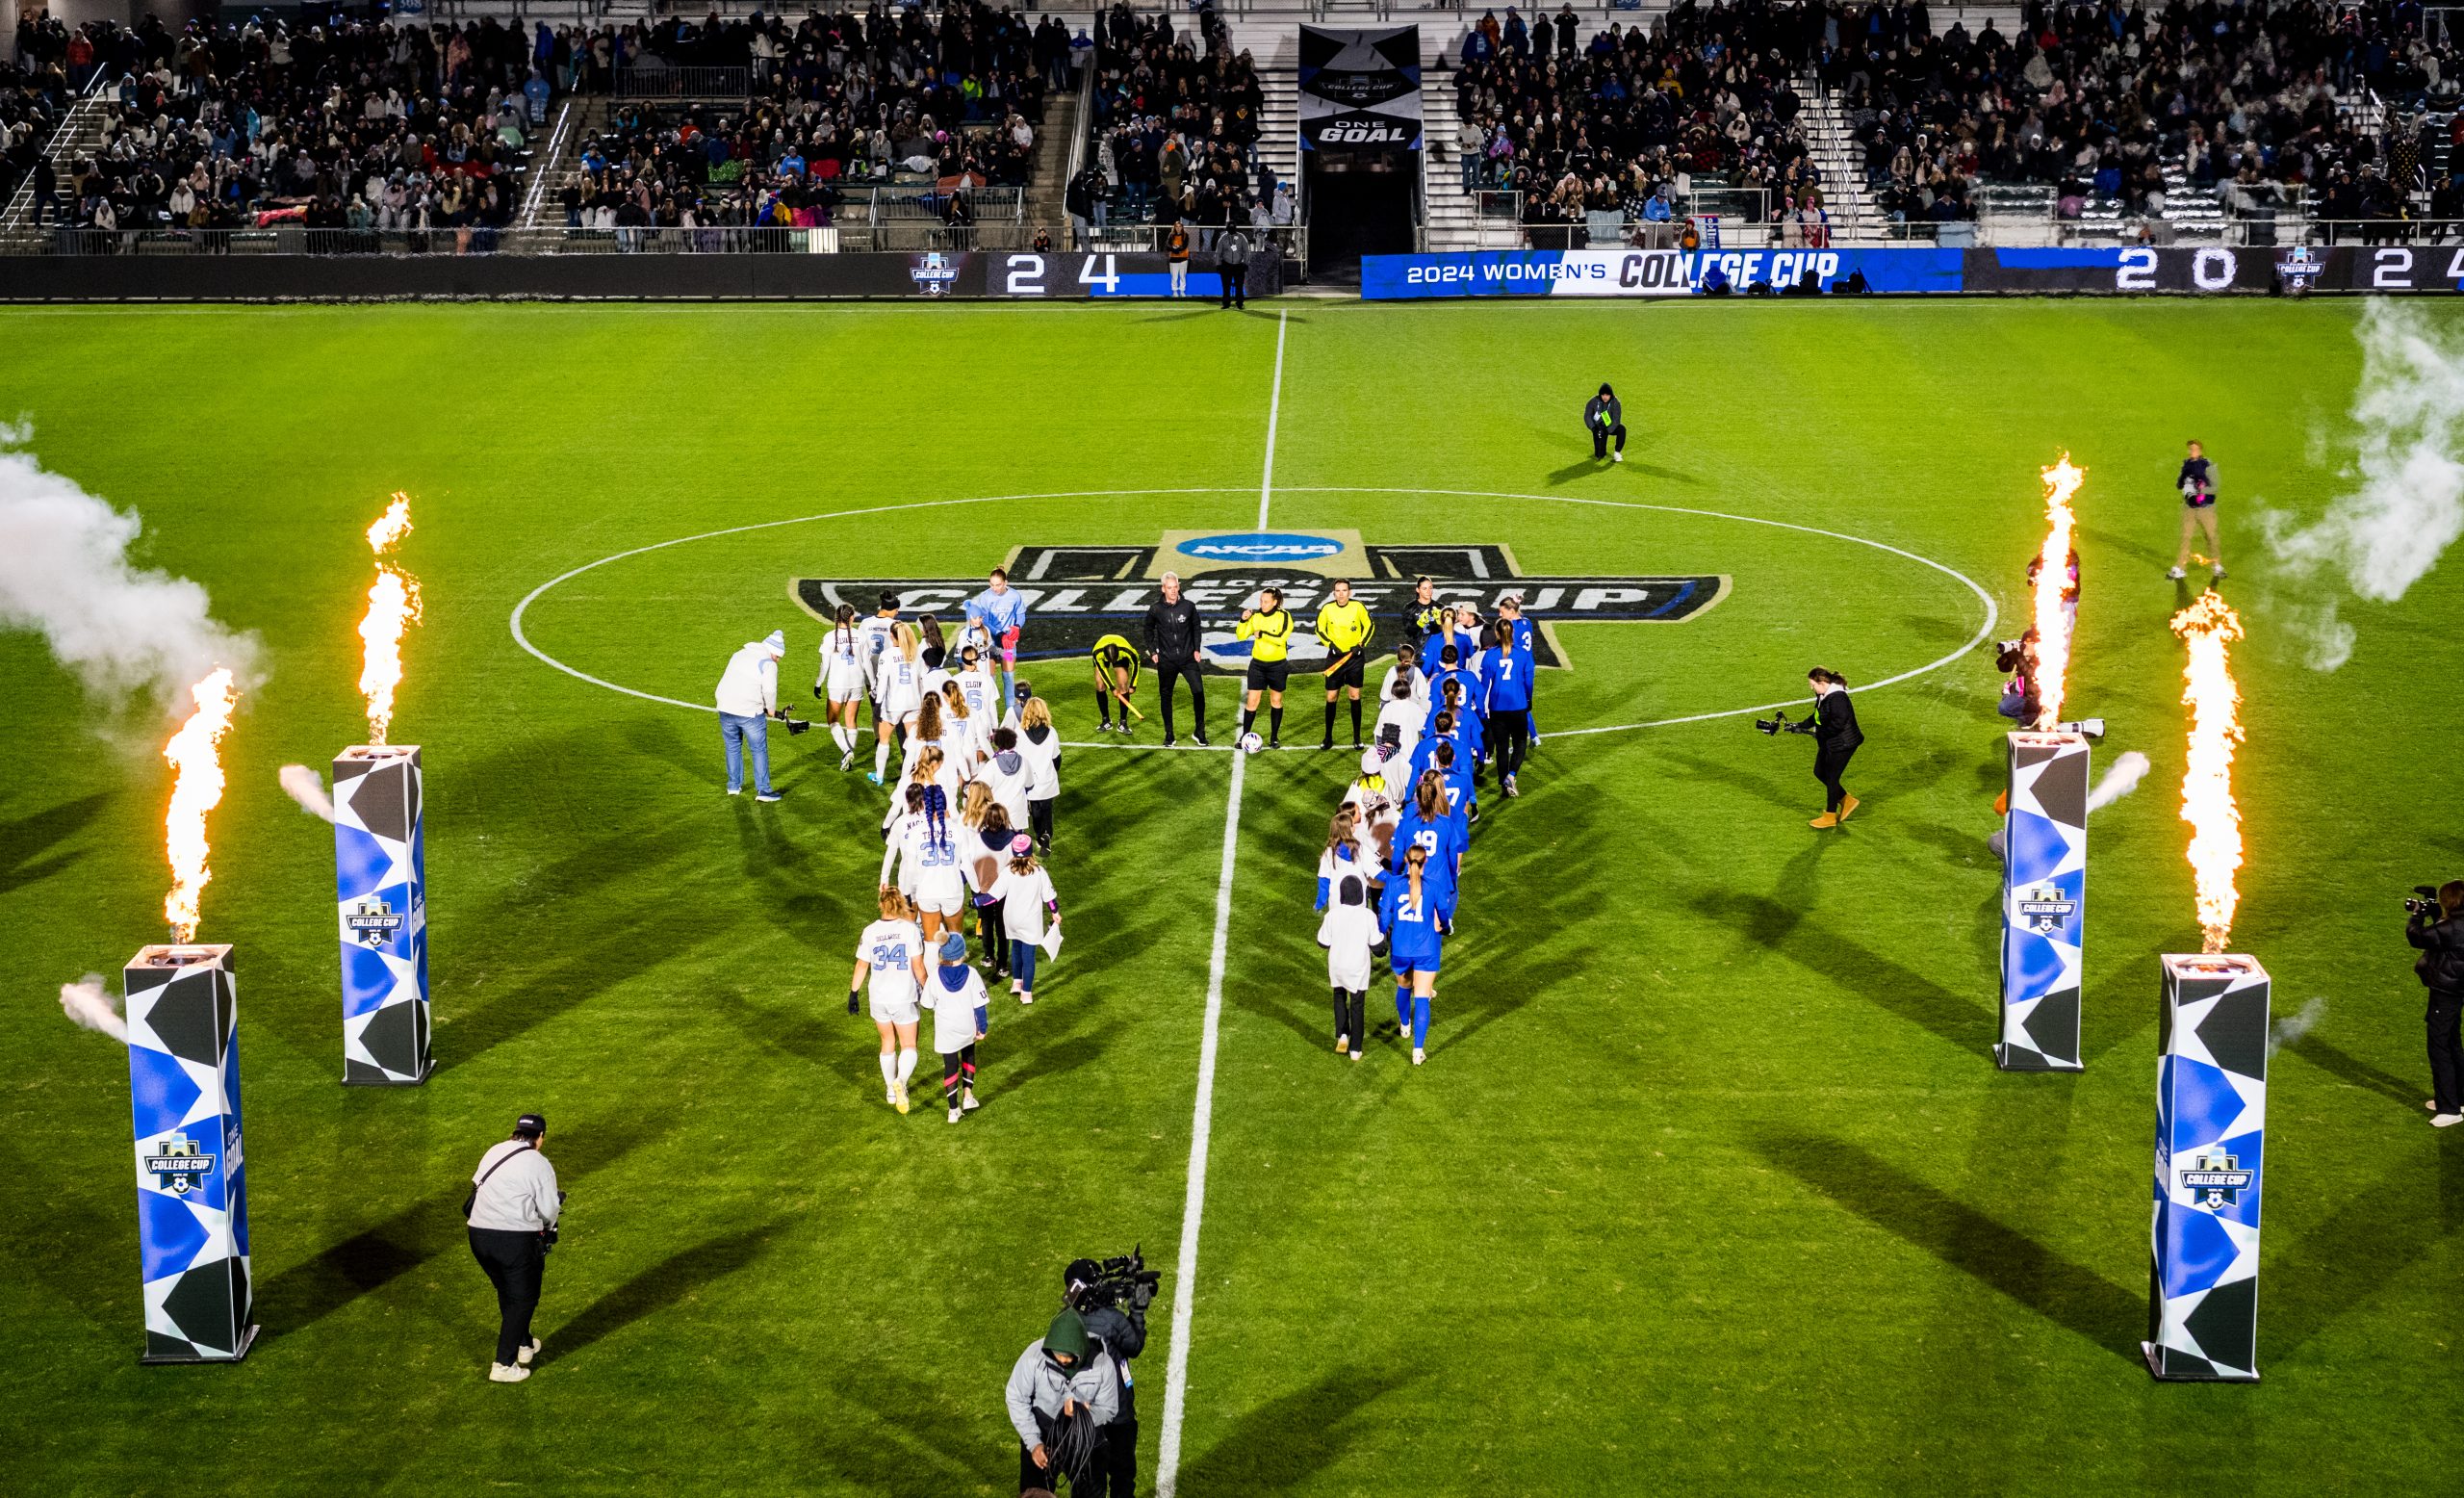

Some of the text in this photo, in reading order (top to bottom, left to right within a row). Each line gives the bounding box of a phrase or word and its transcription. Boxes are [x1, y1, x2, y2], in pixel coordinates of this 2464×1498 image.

[1319, 127, 1405, 142] GOAL
[1007, 254, 1120, 293] 2 4
[1407, 263, 1606, 284] 2024 WOMEN'S
[1619, 252, 1839, 289] COLLEGE CUP
[2116, 247, 2158, 289] 2
[2374, 248, 2413, 287] 2
[1192, 544, 1338, 555] NCAA
[870, 633, 886, 655] 3
[1521, 631, 1532, 652] 3
[840, 645, 856, 665] 4
[899, 663, 911, 684] 5
[1499, 659, 1514, 681] 7
[966, 689, 983, 711] 6
[920, 840, 956, 867] 33
[1413, 830, 1438, 857] 19
[1398, 893, 1424, 922] 21
[351, 917, 399, 927] COLLEGE CUP
[873, 943, 909, 970] 34
[151, 1159, 210, 1171] COLLEGE CUP
[2186, 1174, 2247, 1186] COLLEGE CUP
